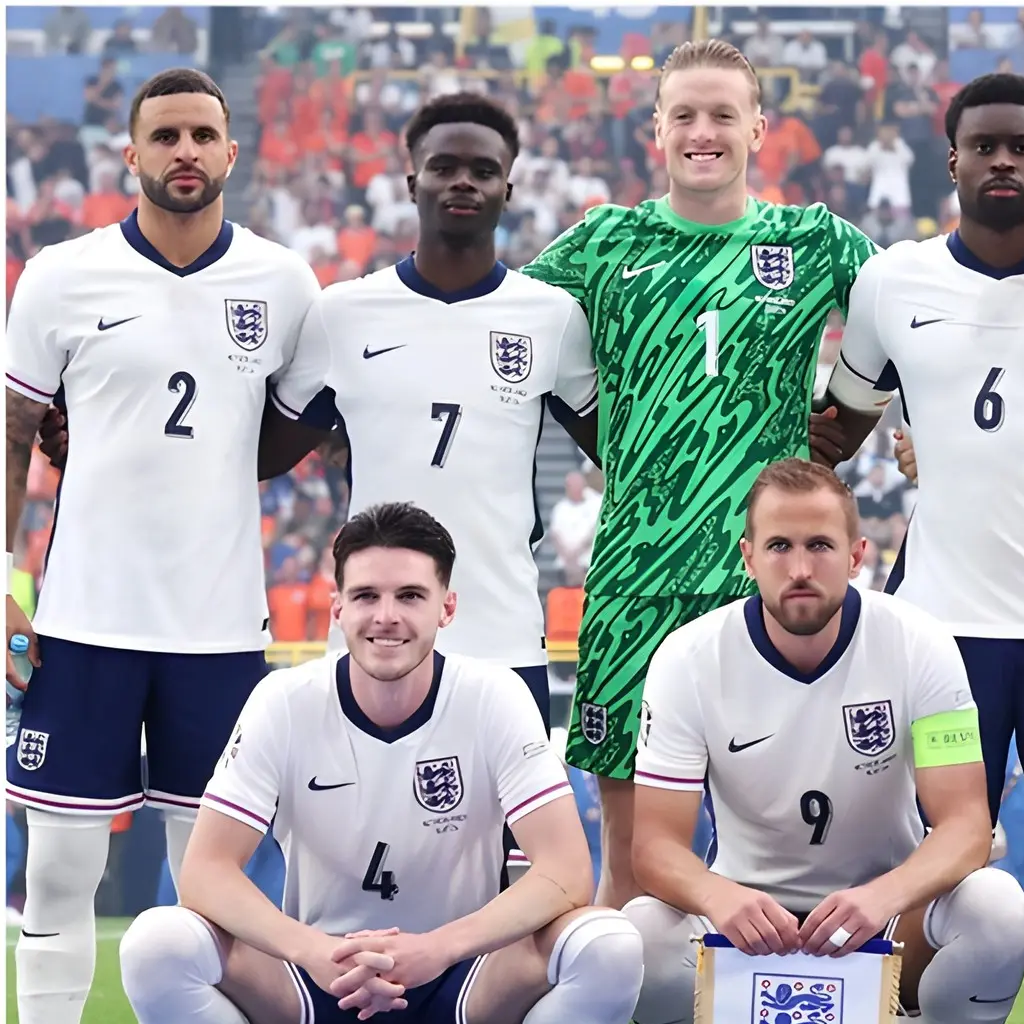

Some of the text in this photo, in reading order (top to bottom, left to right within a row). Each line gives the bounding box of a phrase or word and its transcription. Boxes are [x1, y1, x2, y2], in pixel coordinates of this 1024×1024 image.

[697, 310, 719, 376] 1
[164, 371, 197, 439] 2
[974, 367, 1005, 432] 6
[431, 402, 461, 468] 7
[800, 790, 833, 845] 9
[362, 841, 399, 900] 4
